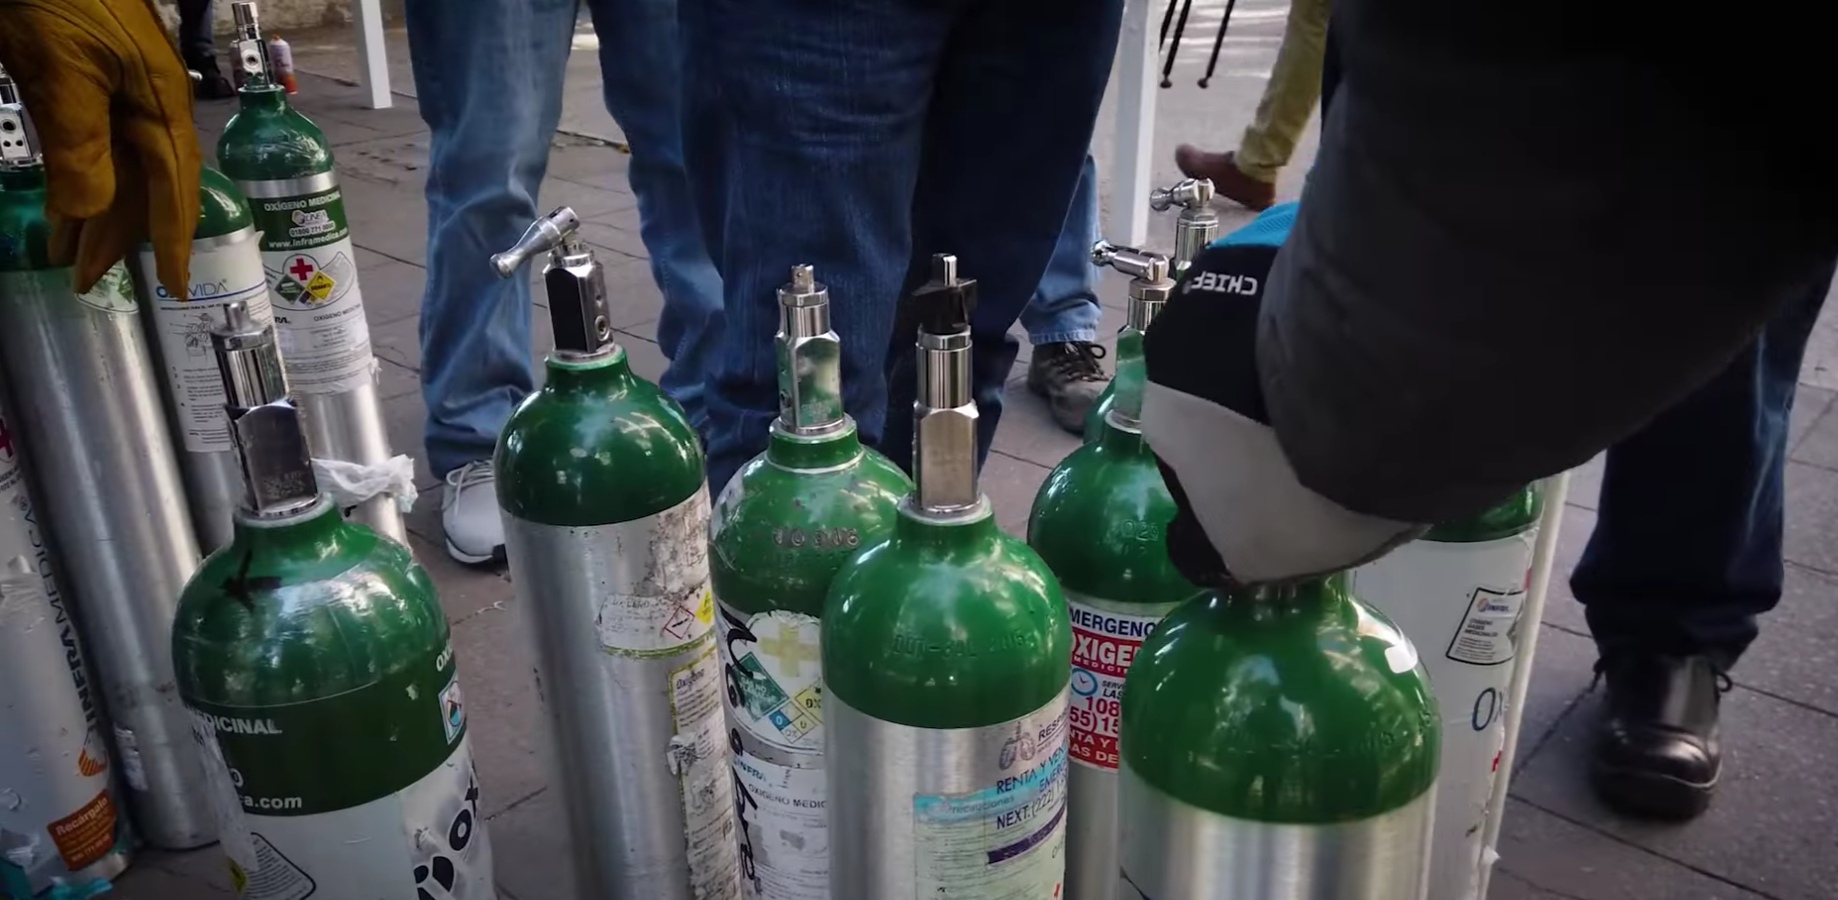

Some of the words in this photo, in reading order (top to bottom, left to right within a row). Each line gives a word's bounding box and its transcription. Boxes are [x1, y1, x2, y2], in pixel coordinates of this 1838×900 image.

[1191, 270, 1258, 296] CHIEF
[996, 768, 1038, 795] RENTA
[1040, 759, 1048, 774] Y
